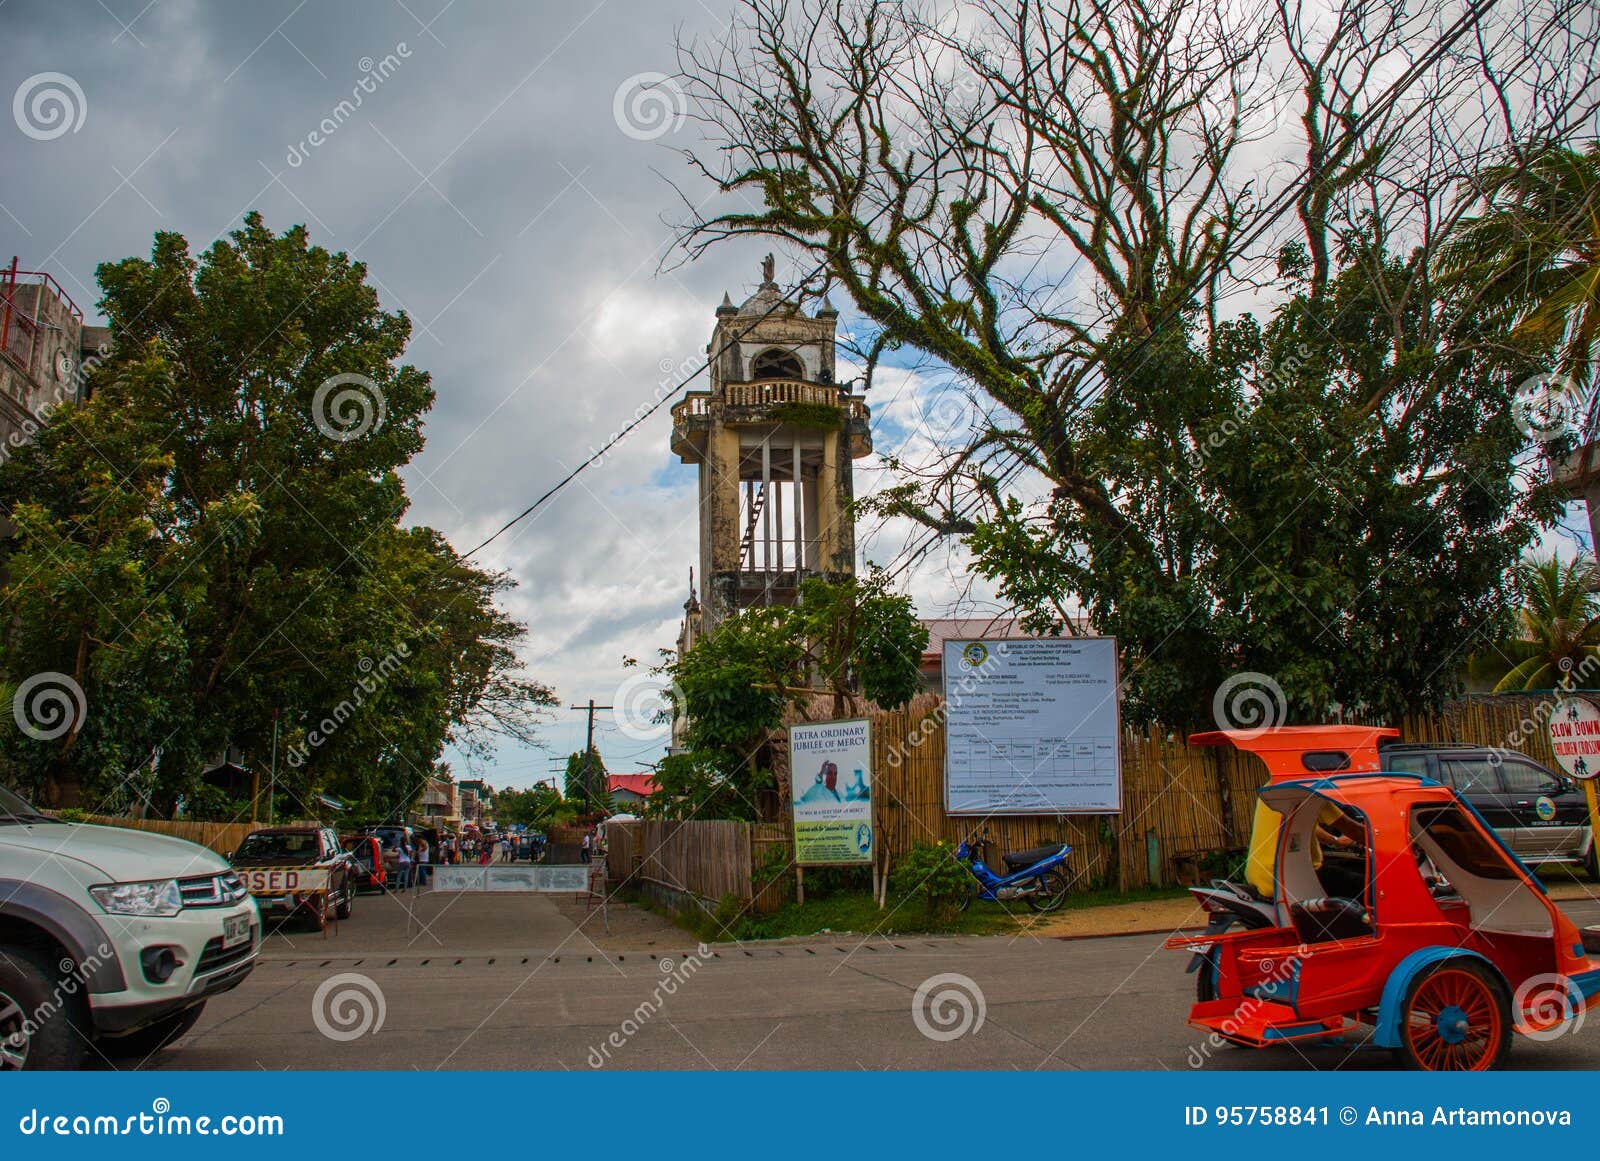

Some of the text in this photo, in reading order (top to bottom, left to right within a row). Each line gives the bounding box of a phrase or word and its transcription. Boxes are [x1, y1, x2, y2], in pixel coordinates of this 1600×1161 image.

[794, 727, 865, 740] EXTRA ORDINARY
[1550, 719, 1600, 738] SLOW DOWN
[793, 741, 823, 752] JUBILEE
[837, 737, 866, 747] MERCY
